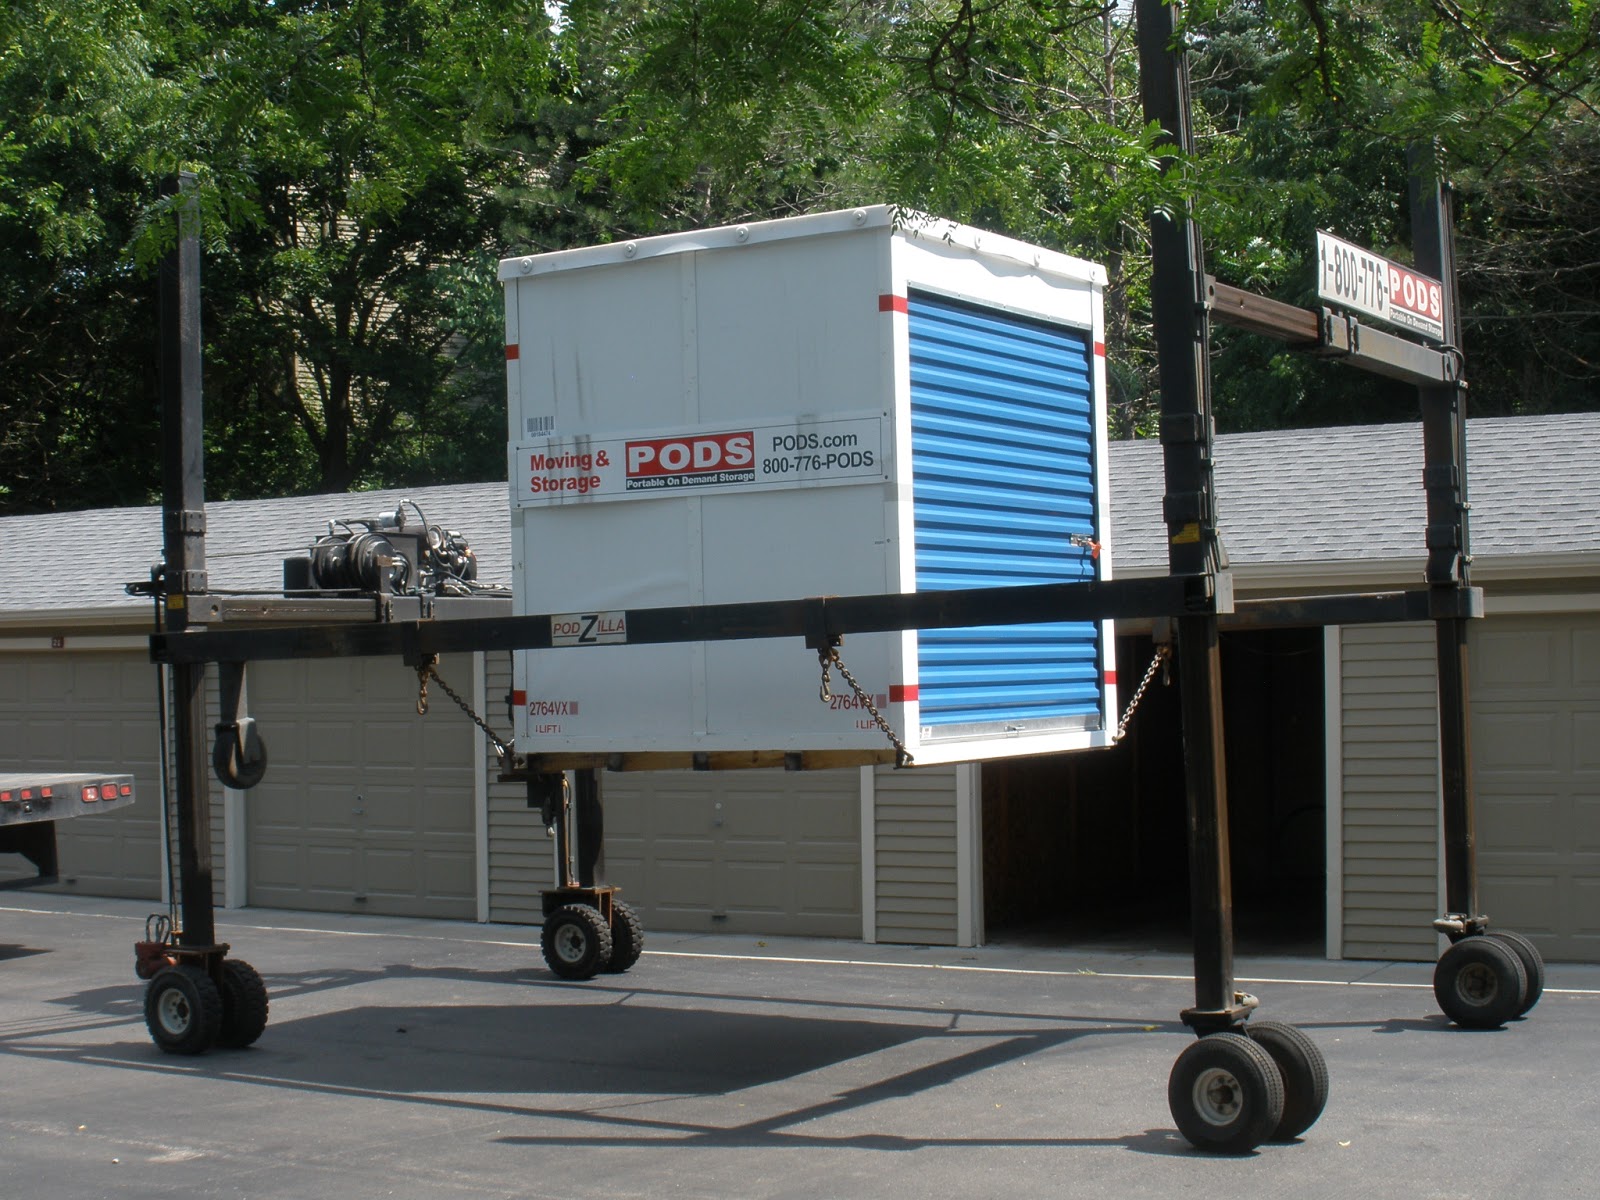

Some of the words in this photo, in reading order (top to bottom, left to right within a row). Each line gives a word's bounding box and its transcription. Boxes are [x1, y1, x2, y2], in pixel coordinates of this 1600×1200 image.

[772, 433, 858, 452] PODS.com
[530, 451, 592, 471] Moving
[595, 450, 610, 467] &
[628, 437, 752, 473] PODS
[762, 450, 874, 474] 800-776-PODS
[530, 475, 601, 493] Storage
[626, 477, 665, 488] Portable
[667, 477, 680, 486] On
[682, 474, 717, 484] Demand
[720, 471, 755, 481] Storage
[553, 615, 625, 643] PODZILLA
[529, 701, 568, 715] 2764VX
[539, 724, 557, 733] LIFT
